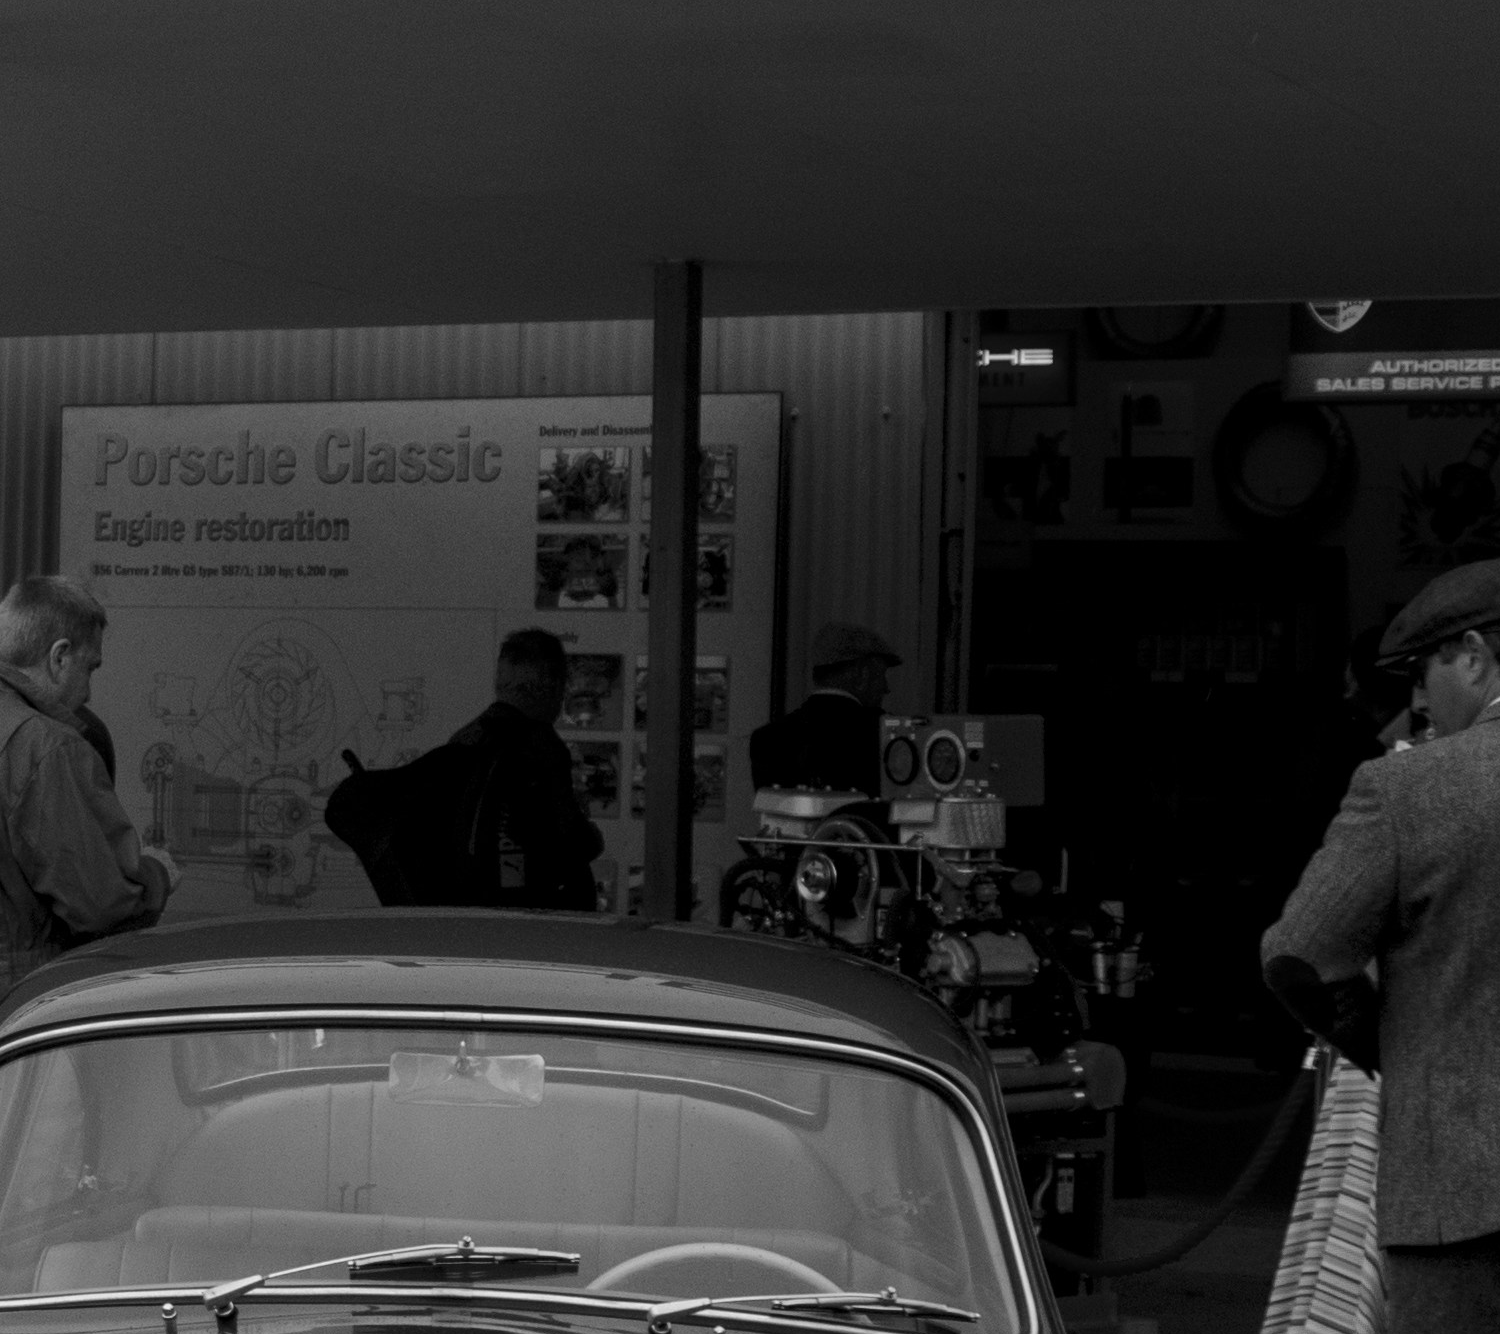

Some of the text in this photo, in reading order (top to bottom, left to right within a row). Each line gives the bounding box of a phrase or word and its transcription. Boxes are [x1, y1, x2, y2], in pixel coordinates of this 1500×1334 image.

[1316, 377, 1385, 392] SALES
[1392, 376, 1483, 390] SERVICE
[539, 425, 577, 437] Delivery
[580, 425, 599, 436] and
[94, 425, 502, 486] Porsche Classic
[94, 508, 350, 547] Engine restoration
